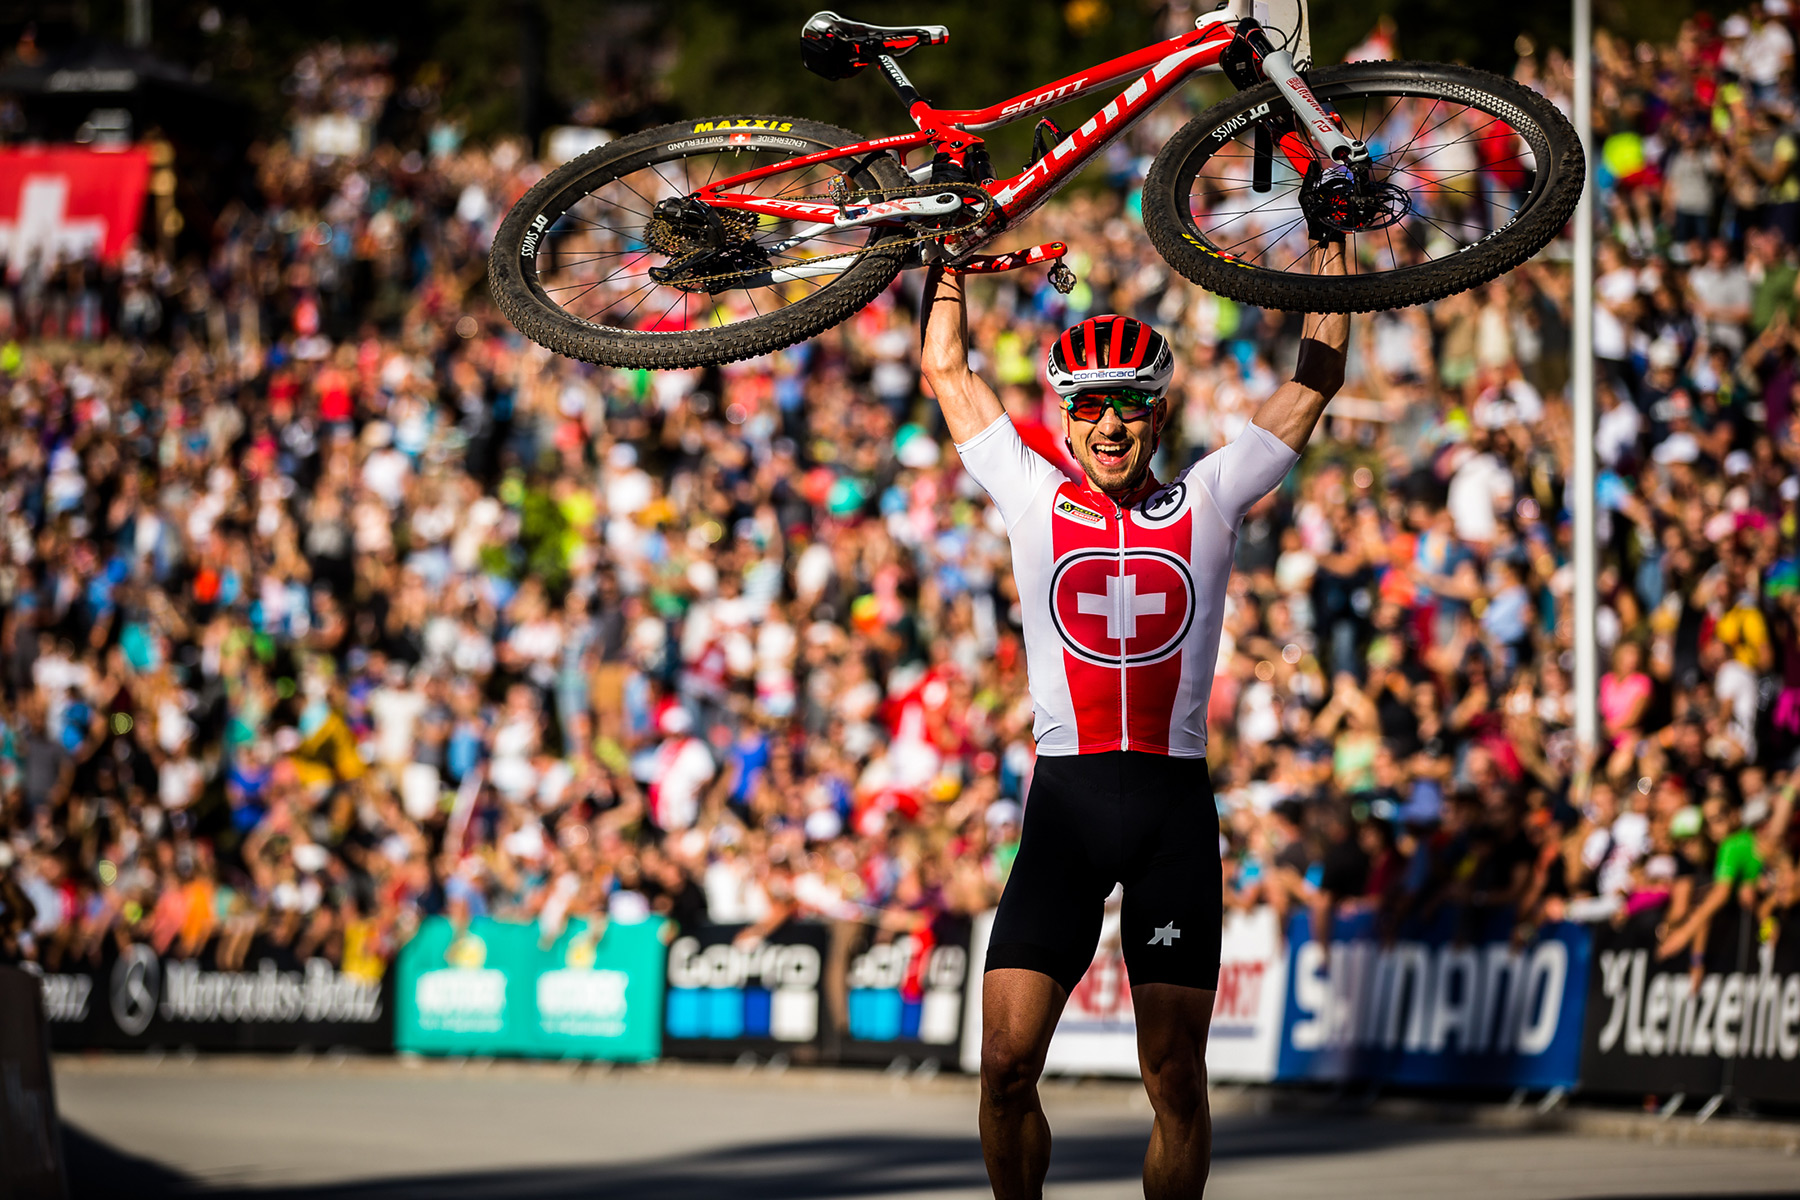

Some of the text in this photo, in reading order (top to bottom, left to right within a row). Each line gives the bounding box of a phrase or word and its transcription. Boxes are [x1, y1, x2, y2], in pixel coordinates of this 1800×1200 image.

[1001, 77, 1089, 116] SCOTT
[693, 119, 793, 134] MAXXIS
[1211, 102, 1271, 142] DT SWISS
[667, 135, 724, 151] SWITZERLAND
[757, 134, 808, 149] LENZERHEIDE
[868, 133, 916, 146] SRAM
[520, 213, 549, 259] DT SWISS
[668, 935, 821, 990] GoPro
